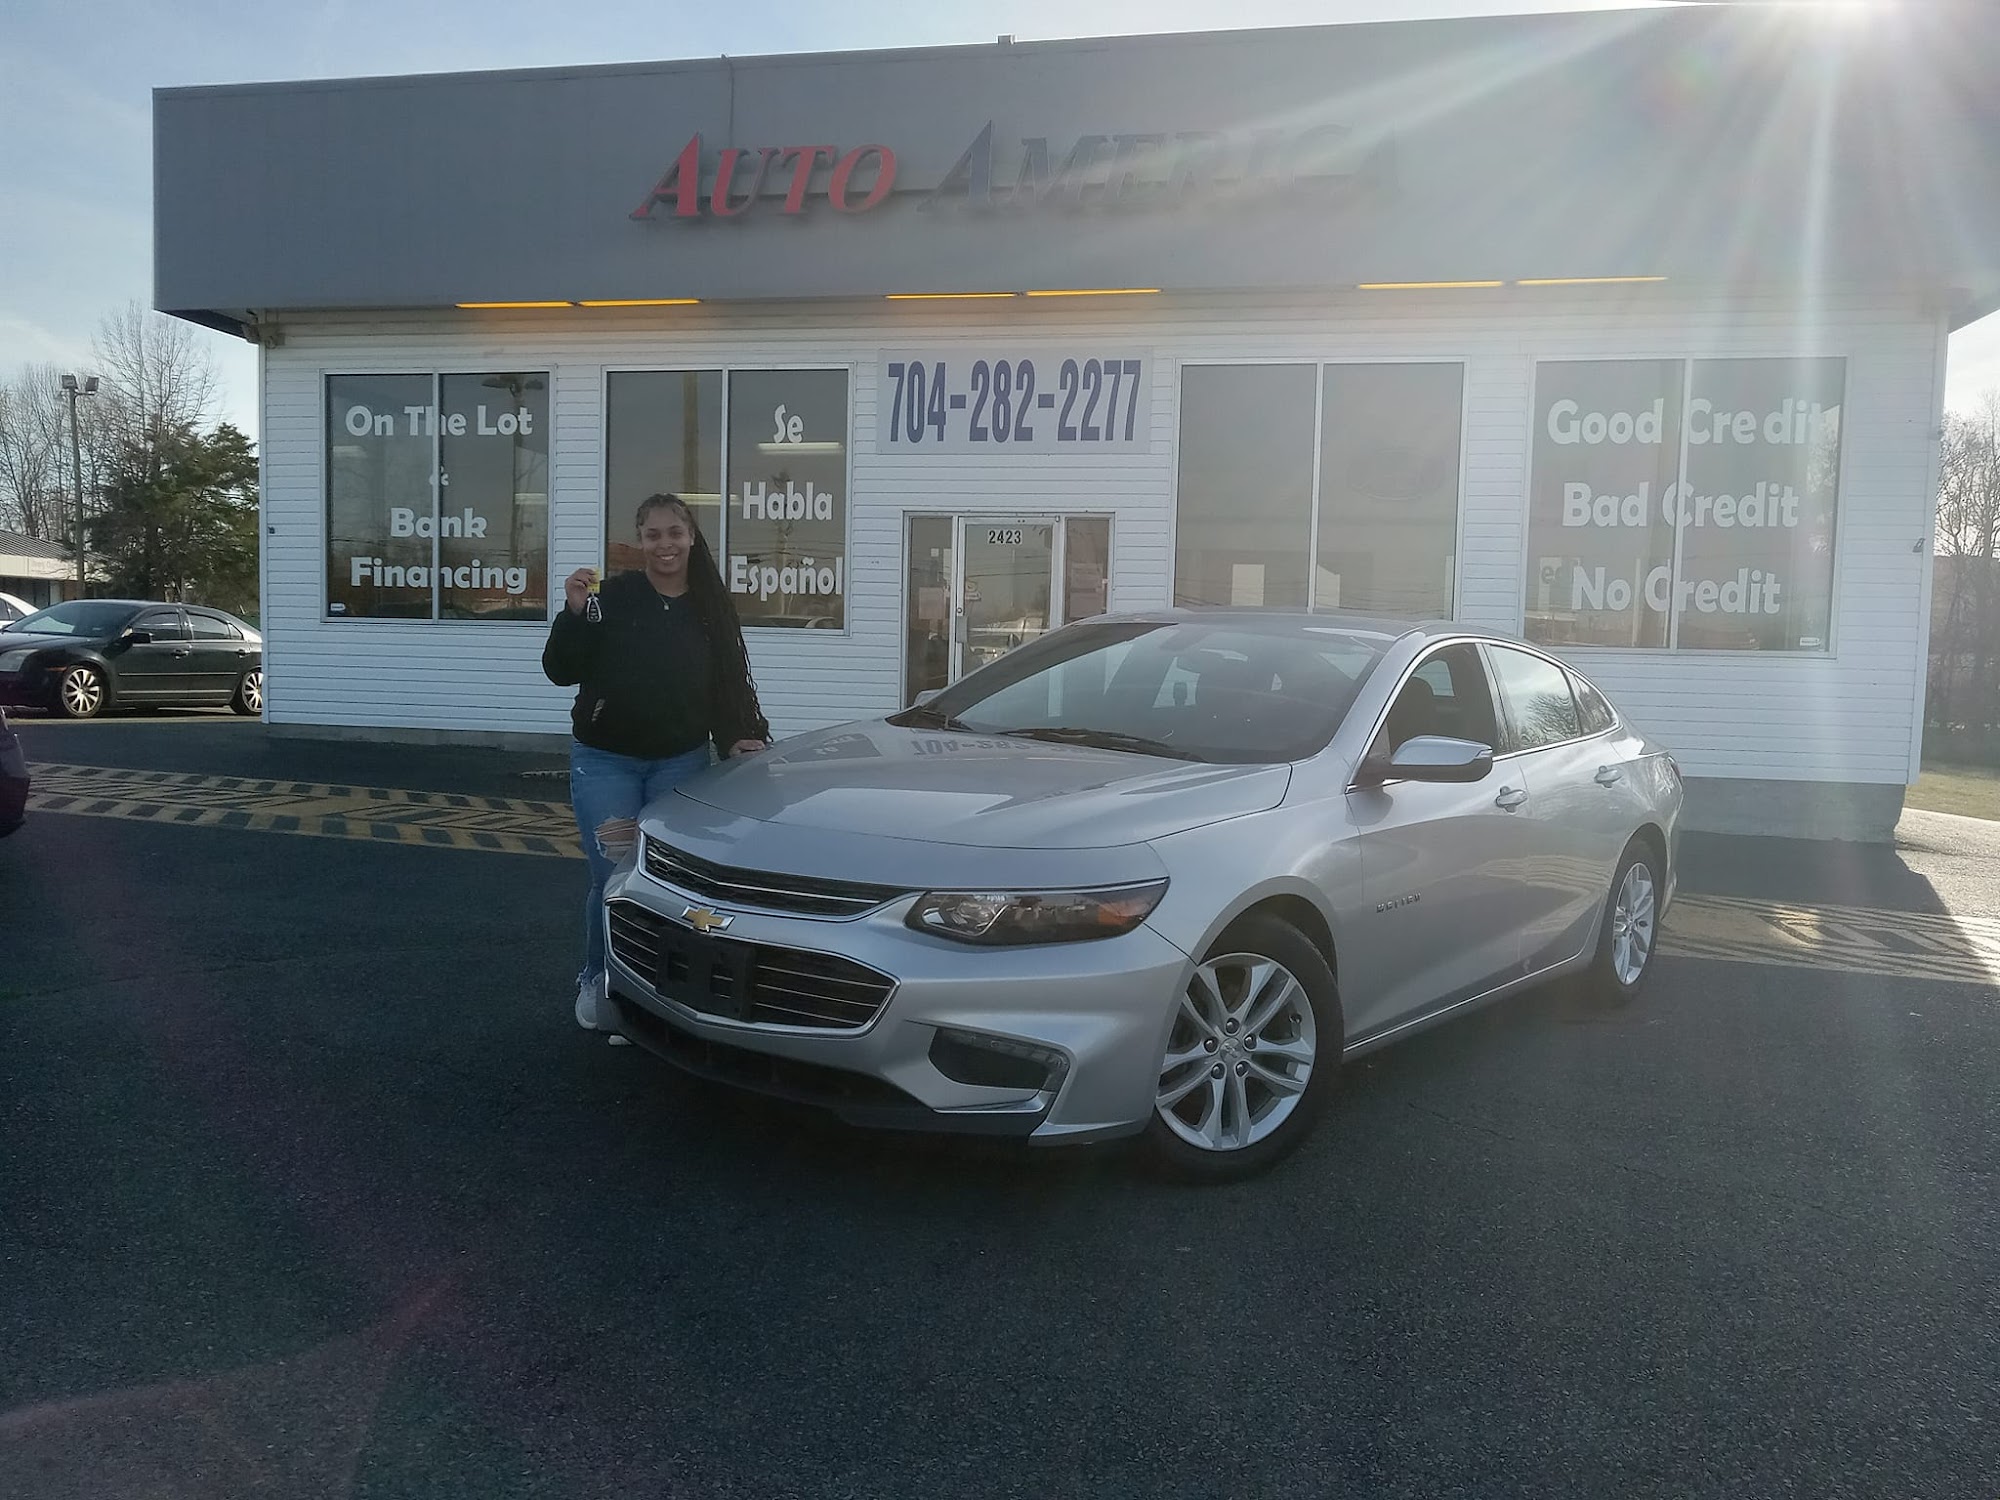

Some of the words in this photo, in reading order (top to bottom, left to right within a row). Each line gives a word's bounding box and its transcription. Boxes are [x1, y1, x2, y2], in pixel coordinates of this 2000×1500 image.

[628, 131, 898, 220] AUTO
[345, 405, 393, 437] On
[404, 405, 466, 436] The
[477, 405, 533, 436] Lot
[888, 359, 1141, 443] 704-282-2277
[1547, 397, 1664, 444] Good
[1684, 398, 1824, 445] Credit
[774, 403, 803, 444] Se
[390, 507, 487, 539] Bank
[742, 481, 833, 522] Habla
[1562, 481, 1650, 528] Bad
[1662, 481, 1799, 528] Credit
[988, 529, 1022, 545] 2423
[351, 557, 527, 595] Financing
[730, 555, 844, 601] Español
[1571, 565, 1632, 611] No
[1644, 565, 1781, 614] Credit
